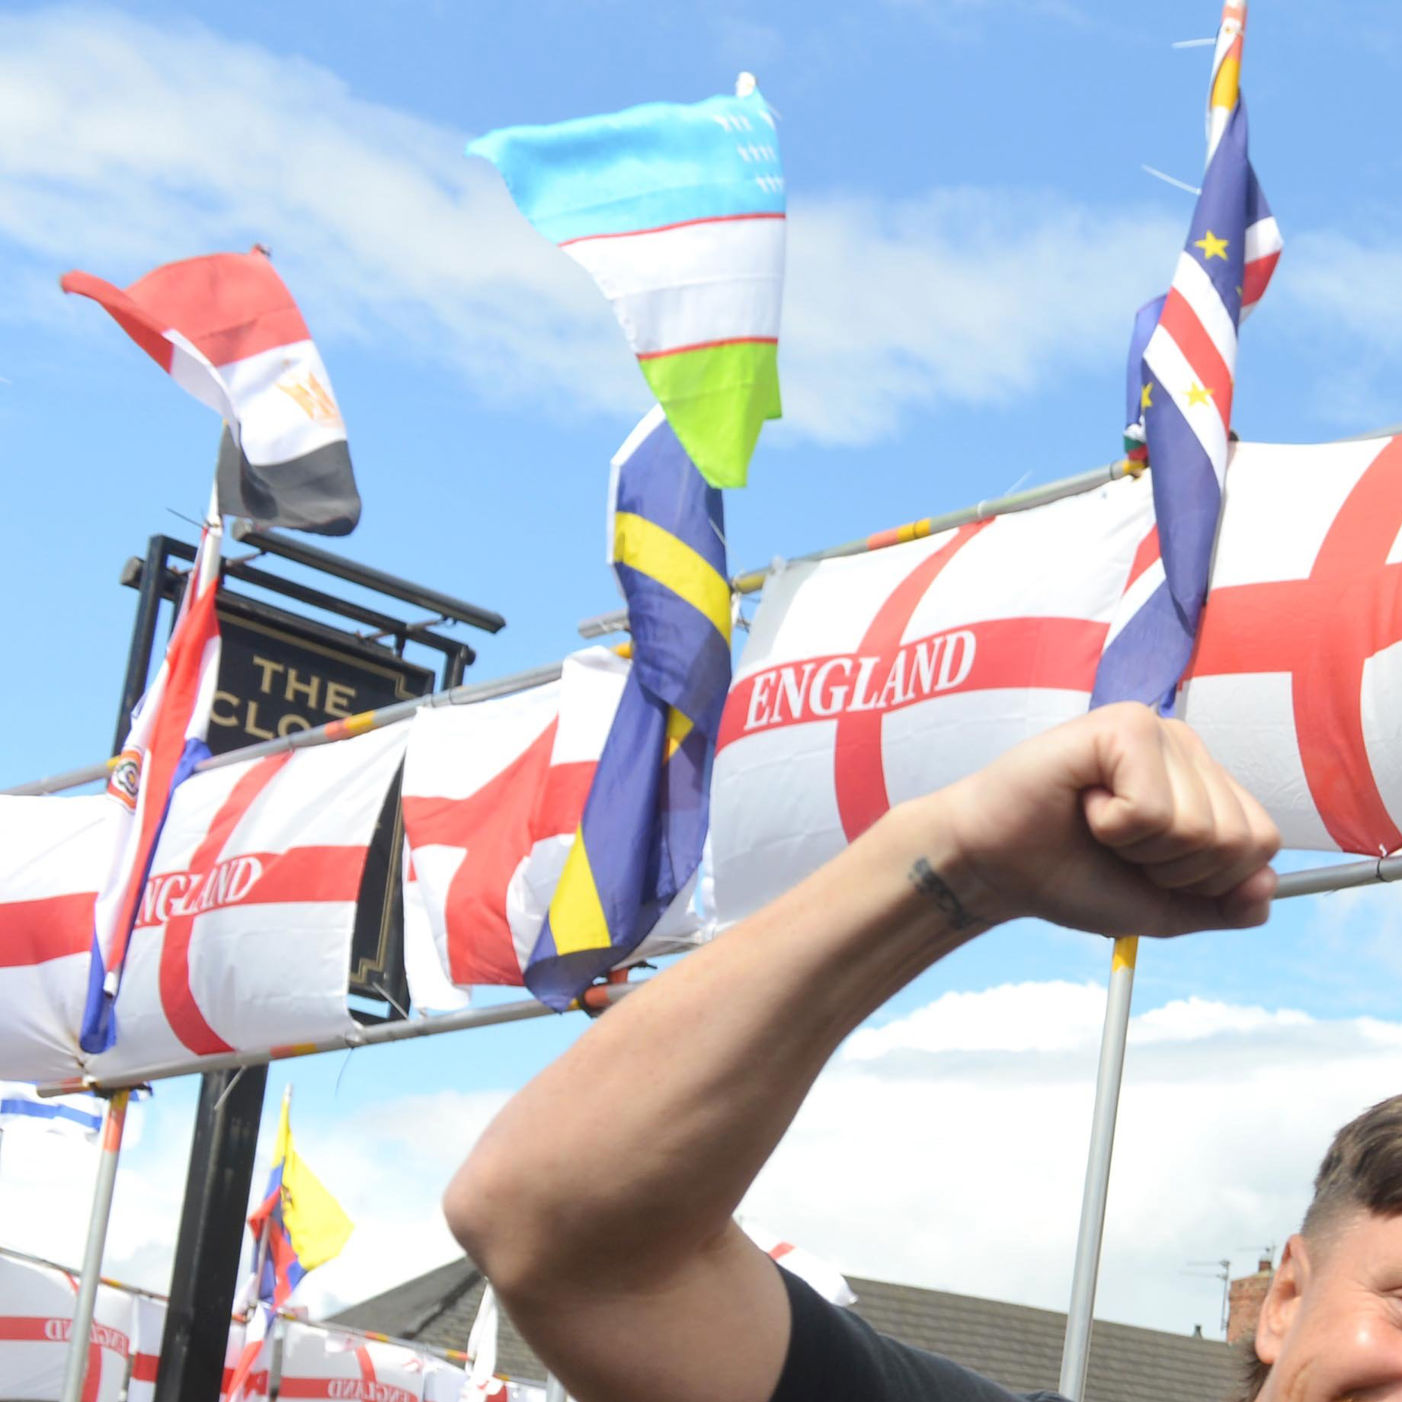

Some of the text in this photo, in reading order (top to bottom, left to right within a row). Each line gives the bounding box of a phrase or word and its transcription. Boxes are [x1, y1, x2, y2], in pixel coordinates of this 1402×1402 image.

[252, 655, 357, 718] THE
[743, 629, 977, 732] ENGLAND
[210, 690, 312, 740] CLO
[136, 856, 263, 924] NGLAND
